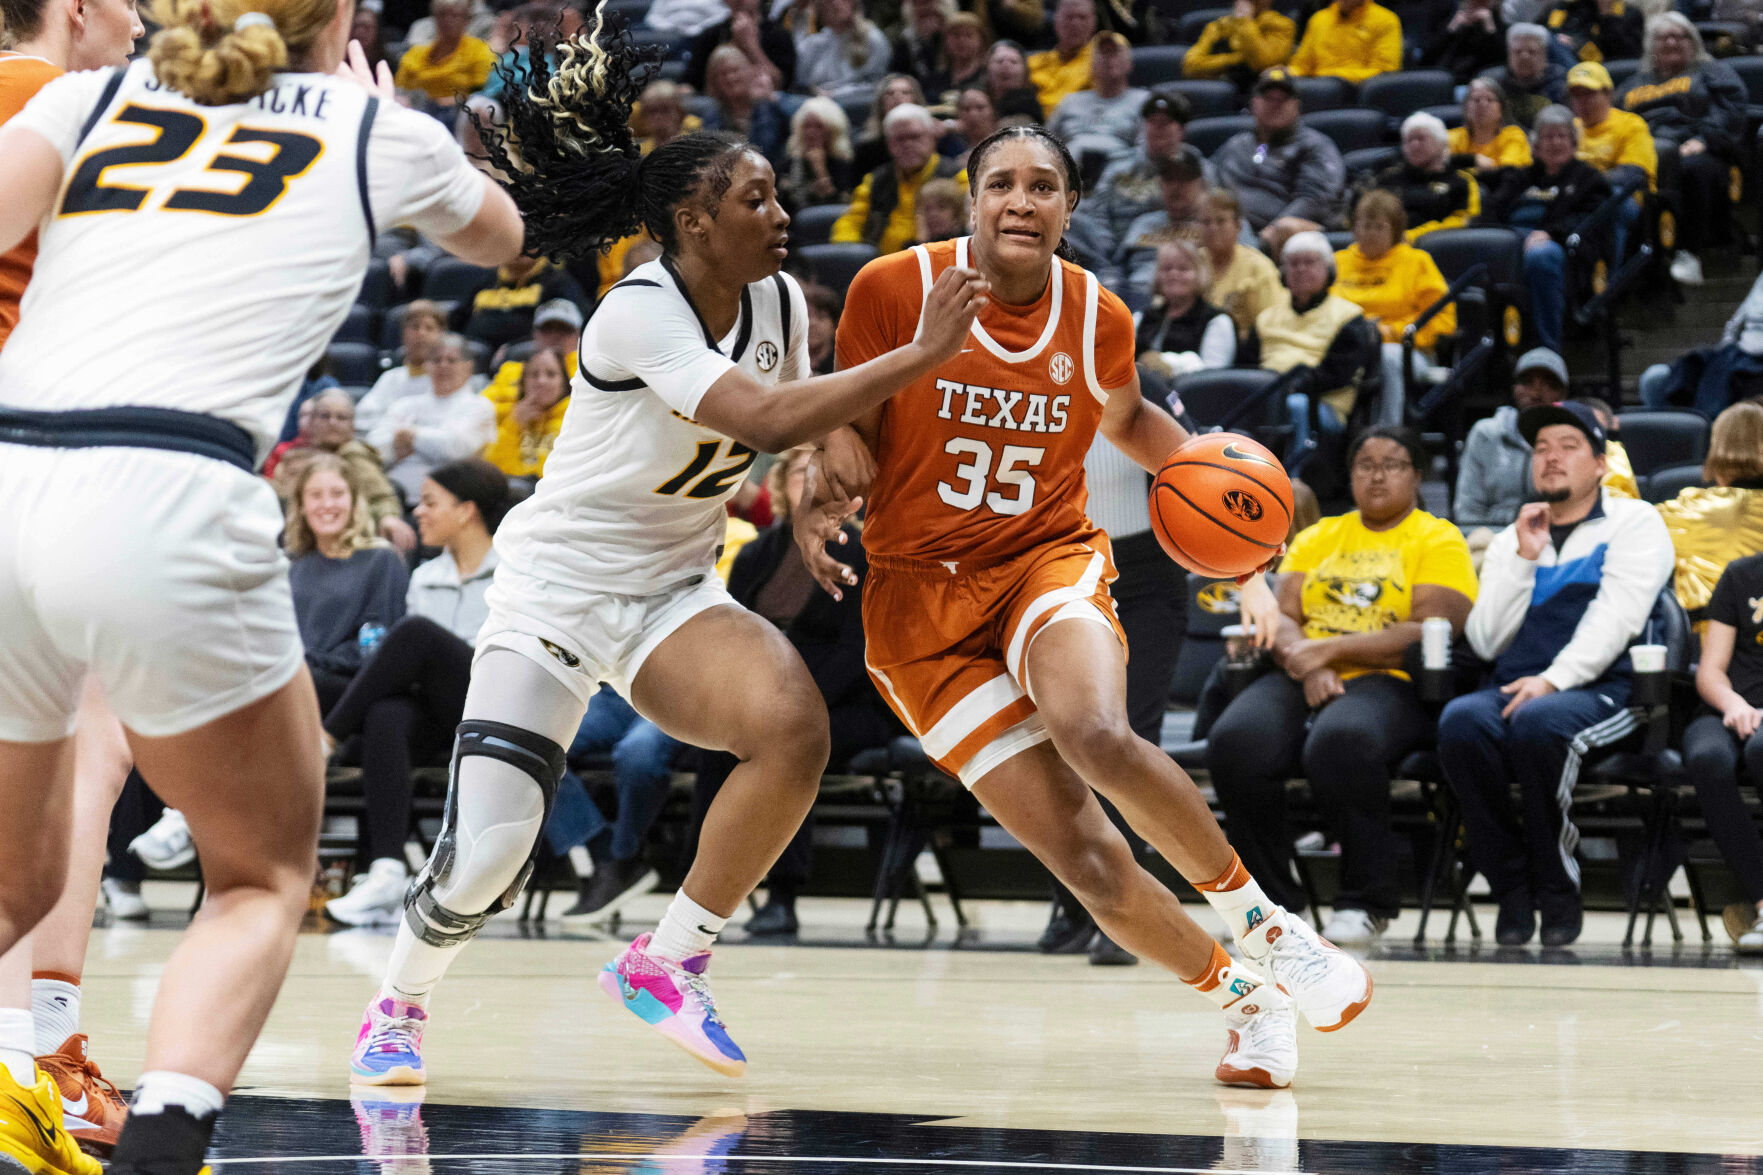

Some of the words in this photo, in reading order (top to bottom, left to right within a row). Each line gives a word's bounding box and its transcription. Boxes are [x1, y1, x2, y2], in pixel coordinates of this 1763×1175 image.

[57, 101, 325, 220] 23
[757, 342, 777, 370] SEC
[1050, 354, 1073, 383] SEC
[935, 378, 1071, 433] TEXAS
[652, 439, 759, 499] 12
[936, 436, 1046, 516] 35
